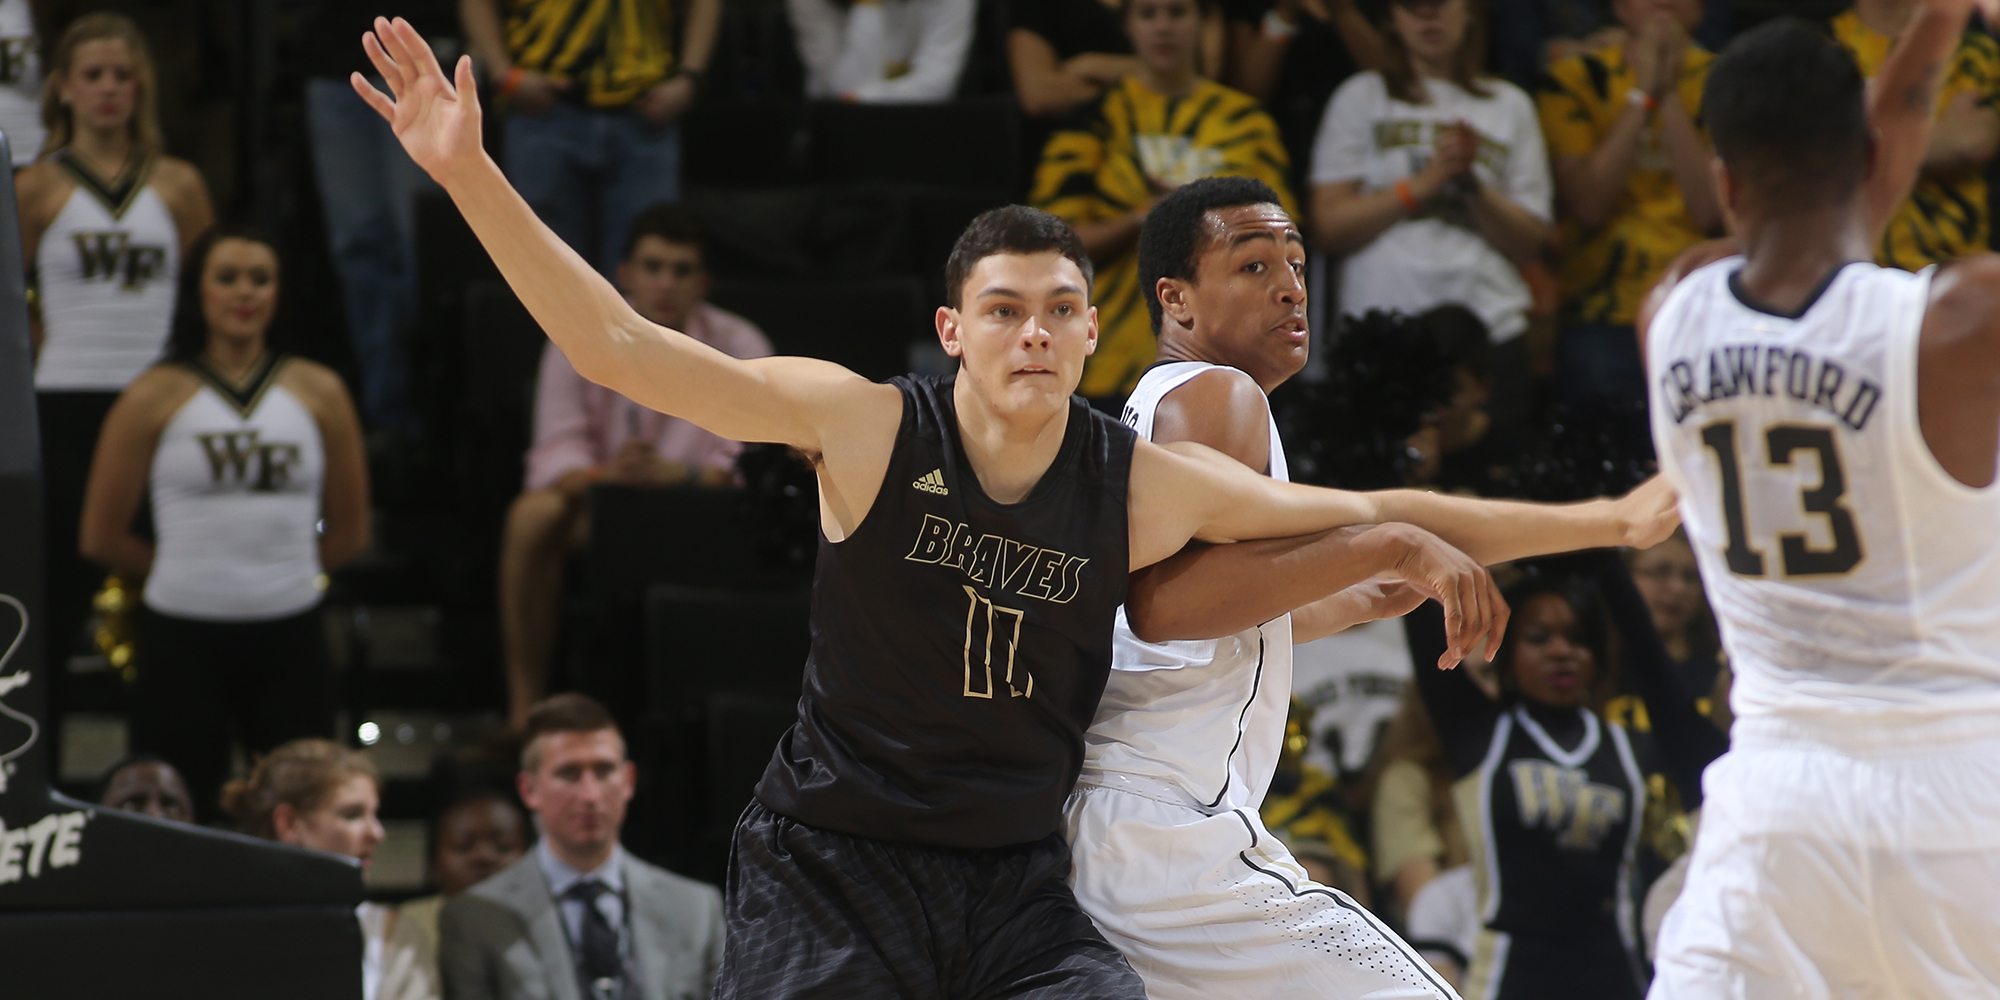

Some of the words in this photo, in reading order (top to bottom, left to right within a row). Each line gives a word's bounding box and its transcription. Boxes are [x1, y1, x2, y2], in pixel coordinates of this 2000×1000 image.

[69, 230, 166, 292] WF
[1661, 345, 1882, 431] CRAWFORD
[195, 430, 302, 493] WF
[912, 481, 949, 496] adidas
[1699, 416, 1869, 578] 13
[905, 513, 1091, 604] BRAVES
[962, 584, 1034, 699] 11
[1508, 758, 1625, 850] WF
[0, 811, 86, 884] ETE
